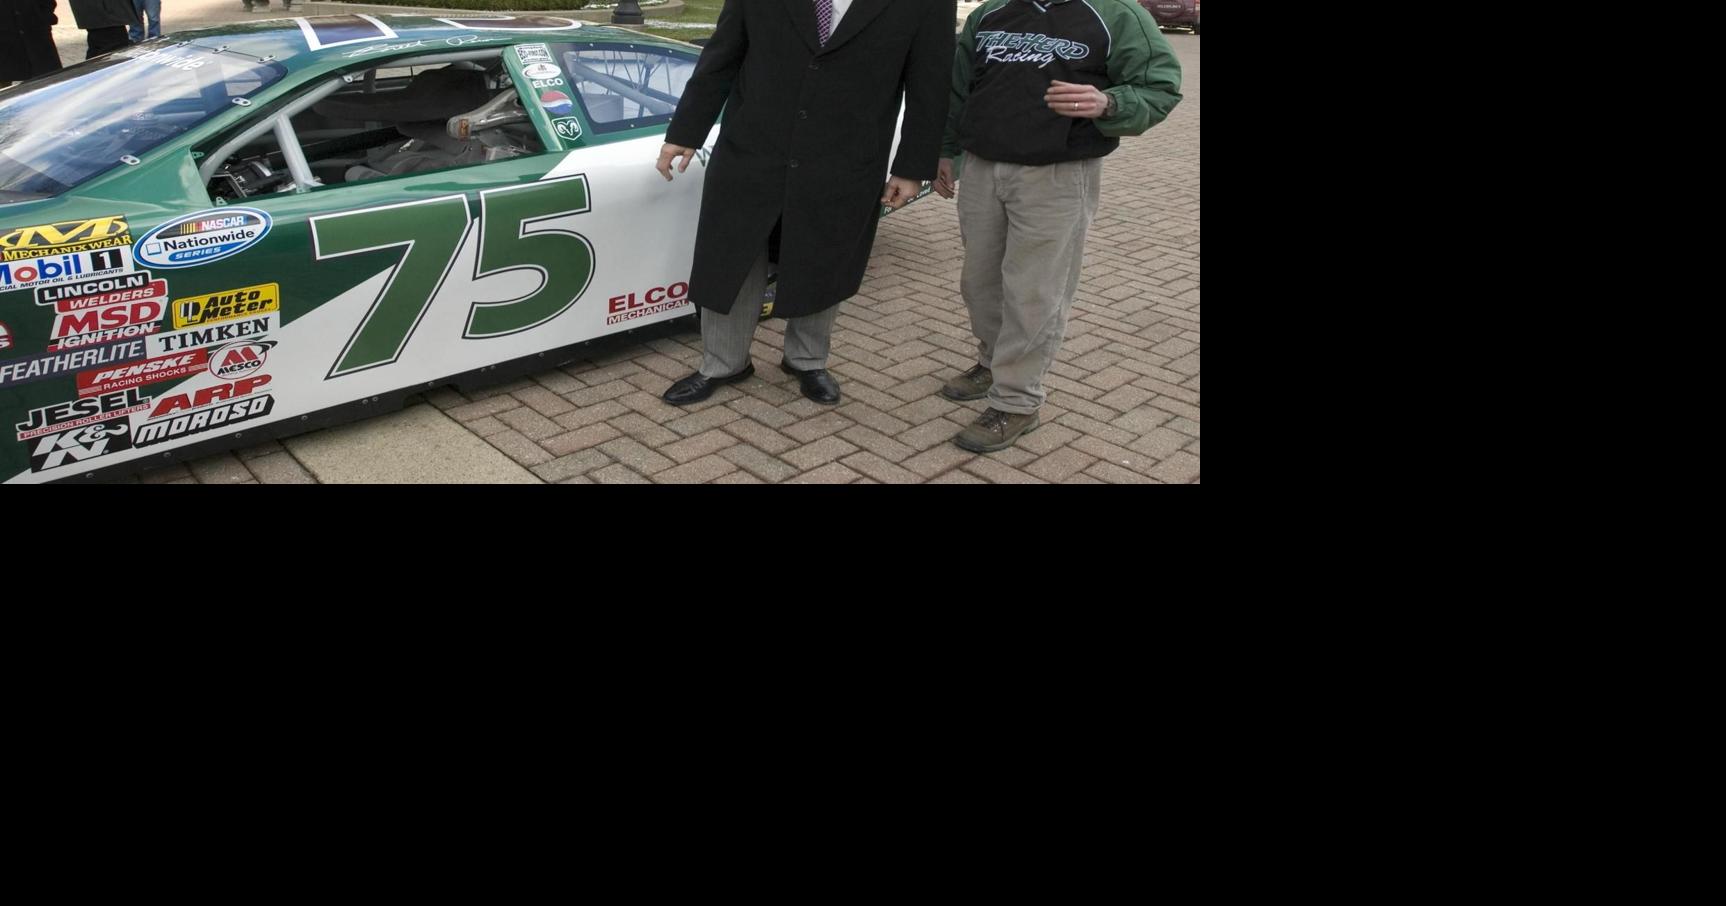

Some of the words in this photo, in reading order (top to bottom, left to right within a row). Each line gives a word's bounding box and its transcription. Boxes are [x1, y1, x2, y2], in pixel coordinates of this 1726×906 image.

[985, 46, 1057, 69] Racing
[532, 78, 564, 89] ELCO
[201, 216, 246, 232] NASCAR
[4, 243, 89, 262] MECHANIX
[89, 234, 132, 251] WEAR
[163, 228, 256, 252] Nationwide
[175, 246, 222, 260] SERIES
[20, 279, 50, 288] MOTOR
[75, 268, 124, 280] LUBRICANTS
[43, 275, 144, 301] LINCOLN
[308, 173, 596, 381] 75
[69, 287, 155, 311] WELDERS
[205, 290, 261, 309] Auto
[608, 281, 689, 314] ELCO
[58, 301, 161, 338] MSD
[199, 298, 273, 324] Meter
[608, 299, 689, 325] MECHANICAL
[56, 322, 156, 349] IGNITION
[159, 316, 270, 352] TIMKEN
[0, 341, 144, 384] FEATHERLITE
[92, 354, 195, 384] PENSKE
[216, 359, 262, 376] MESCO
[103, 376, 143, 391] RACING
[145, 366, 187, 382] SHOCKS
[17, 387, 150, 432] JESEL
[149, 374, 272, 419] ARP
[24, 421, 75, 439] PRECISION
[75, 411, 112, 427] ROLLER
[113, 402, 149, 417] LIFTERS
[136, 395, 271, 446] MOROSO
